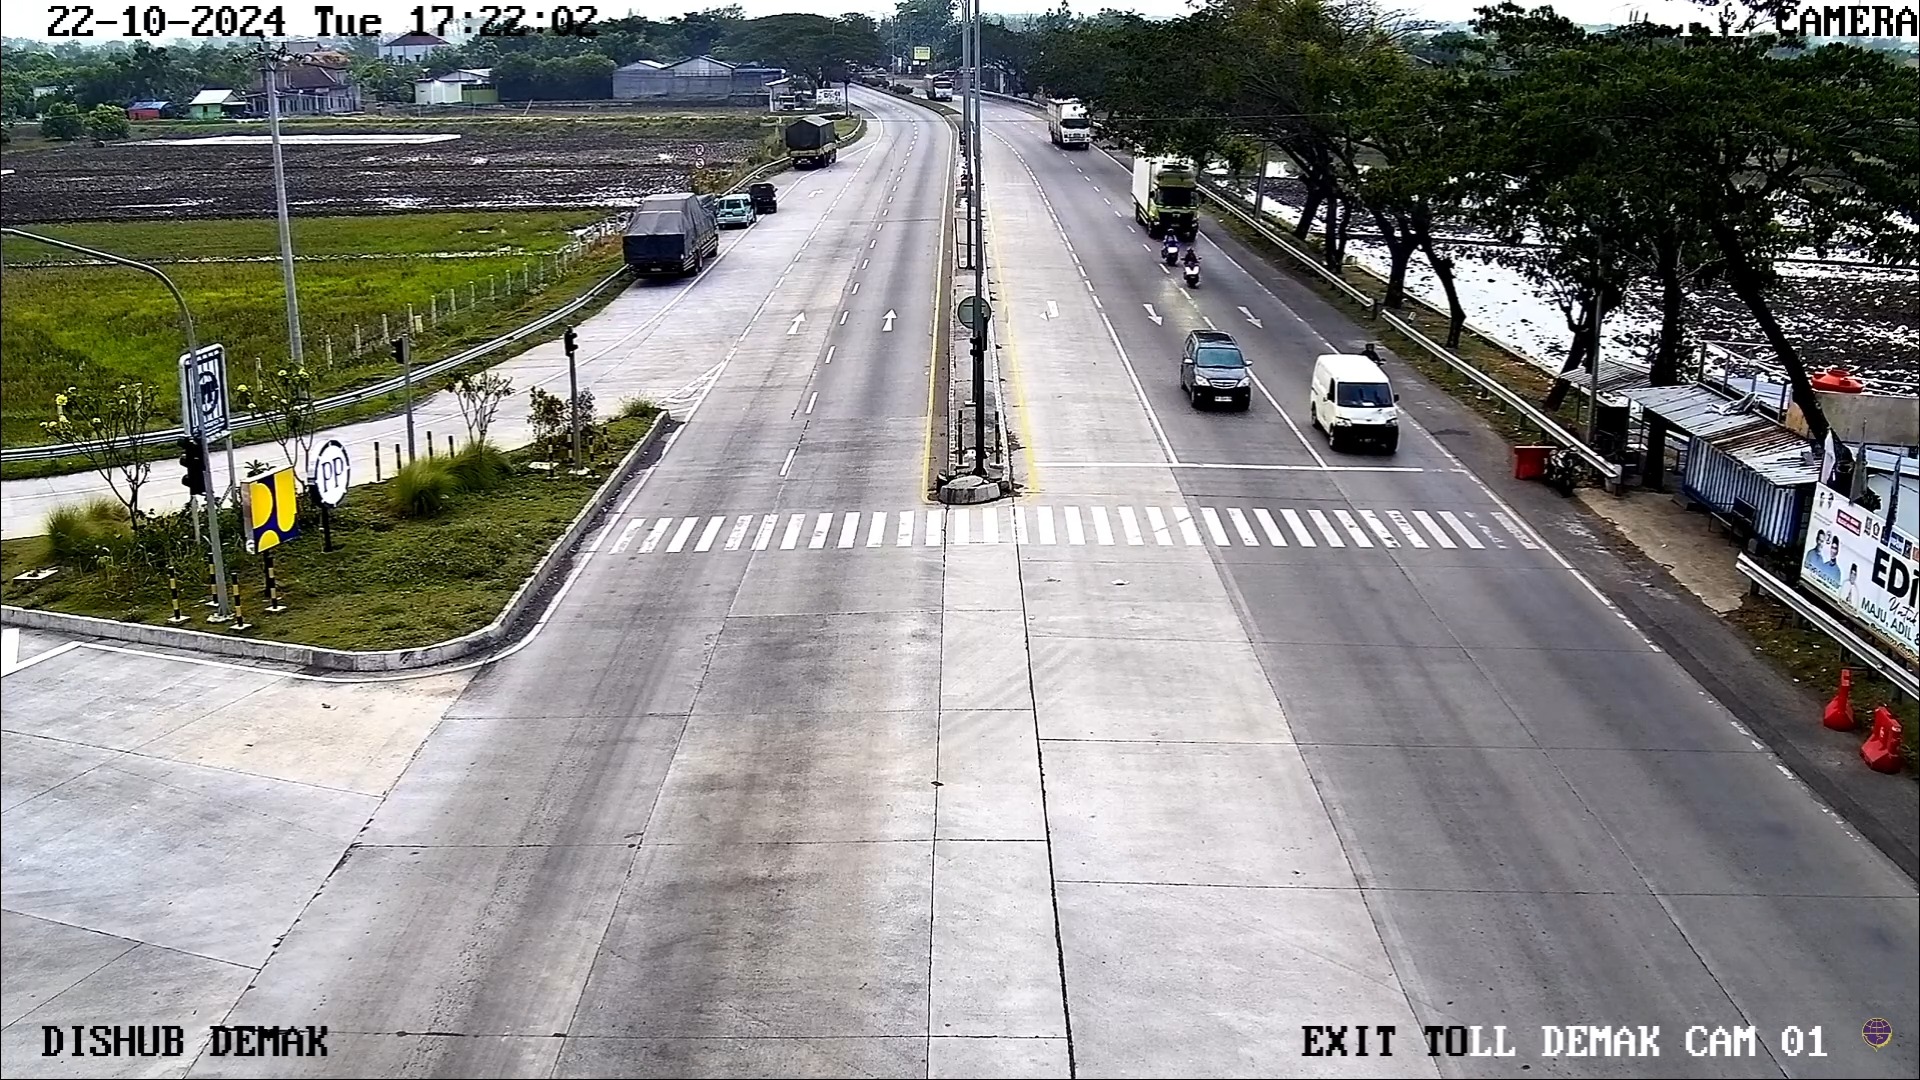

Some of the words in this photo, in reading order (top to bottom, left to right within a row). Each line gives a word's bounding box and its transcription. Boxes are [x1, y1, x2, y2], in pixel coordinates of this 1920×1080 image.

[321, 456, 344, 493] PP
[1861, 597, 1889, 627] MAJU,
[1890, 618, 1912, 641] ADIL
